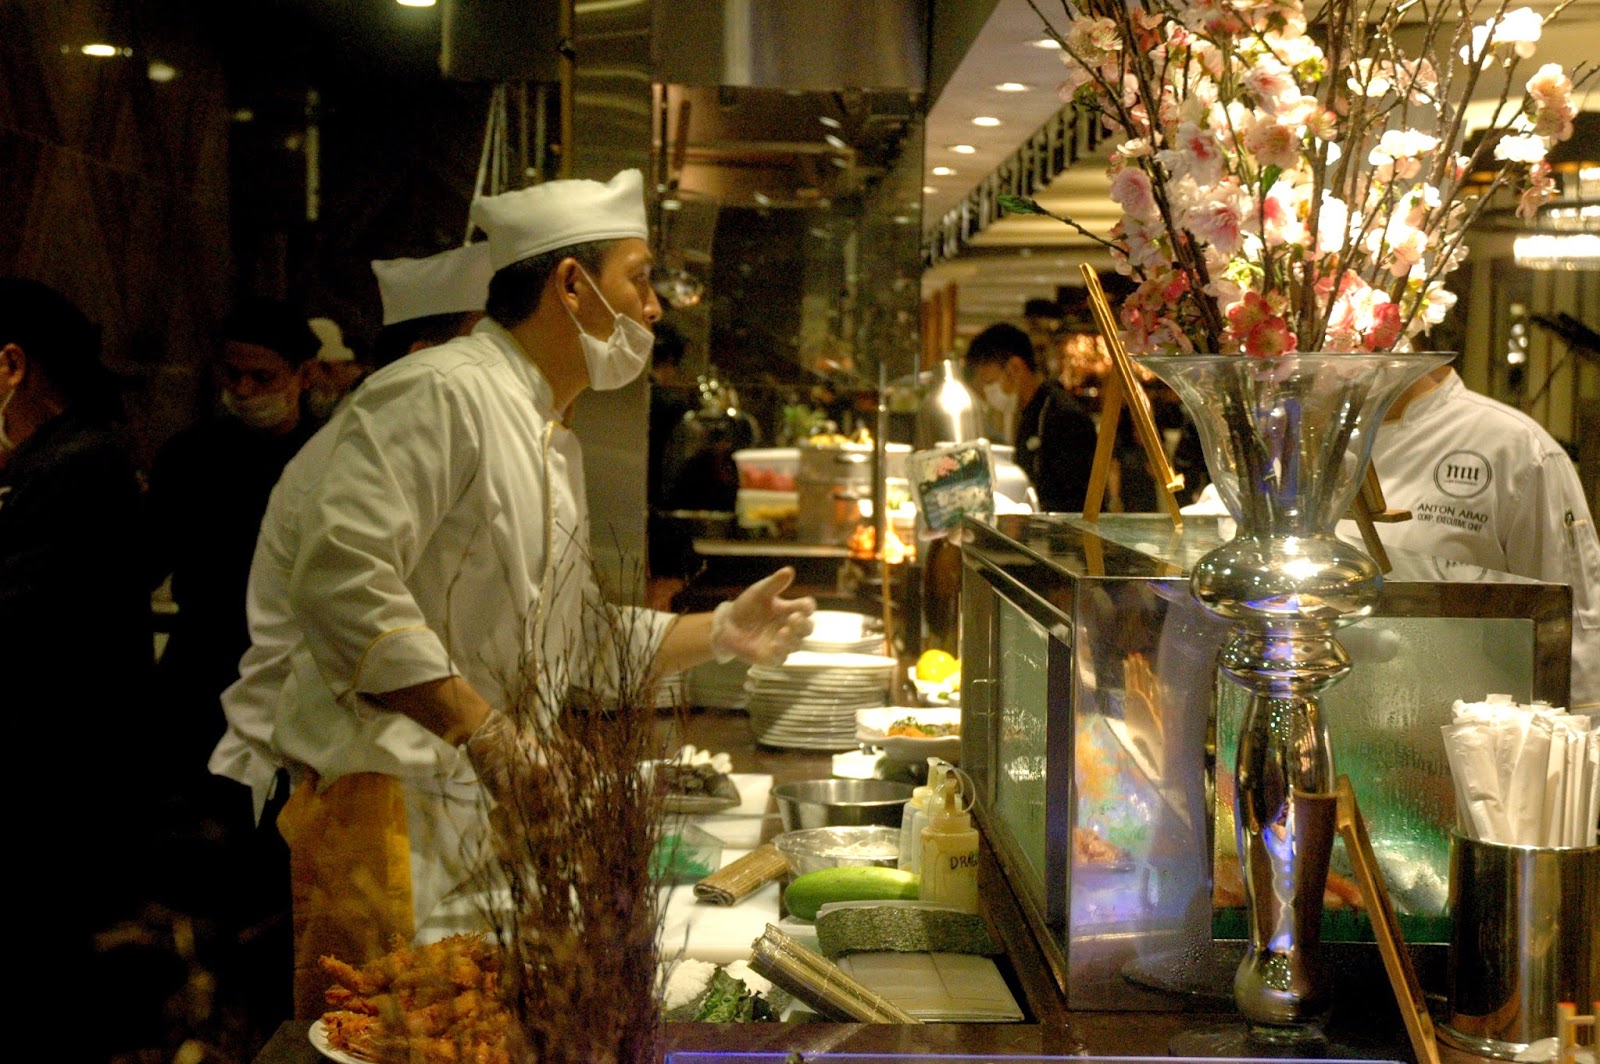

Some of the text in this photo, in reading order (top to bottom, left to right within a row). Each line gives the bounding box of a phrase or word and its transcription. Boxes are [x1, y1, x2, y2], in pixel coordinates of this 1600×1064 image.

[1417, 503, 1488, 523] ANTON ABAD
[1436, 515, 1467, 528] EXECUTIVE
[1468, 522, 1482, 533] CHEF
